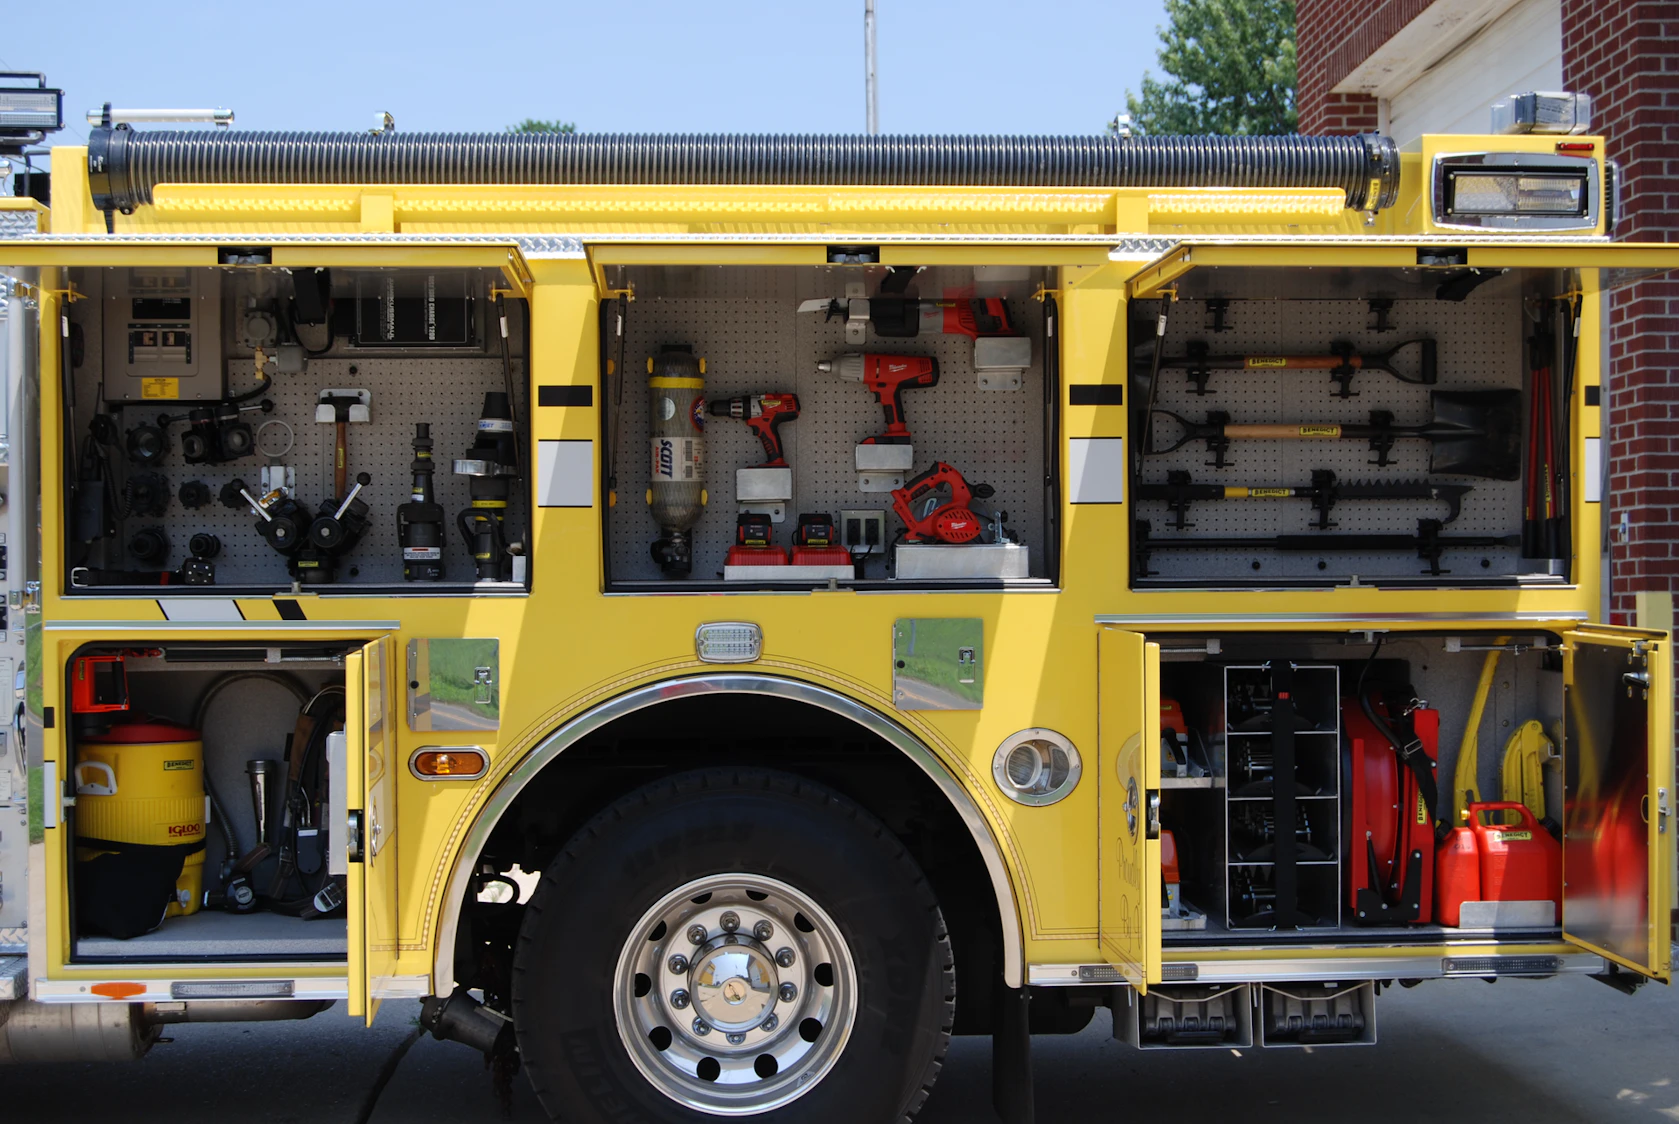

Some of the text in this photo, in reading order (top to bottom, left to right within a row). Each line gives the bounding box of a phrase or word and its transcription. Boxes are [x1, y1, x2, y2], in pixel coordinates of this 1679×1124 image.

[428, 302, 436, 324] CHARGE
[428, 325, 436, 340] 1200
[1251, 357, 1283, 365] BENEDICT
[660, 439, 673, 479] SCOTT
[168, 823, 200, 837] IGLOO
